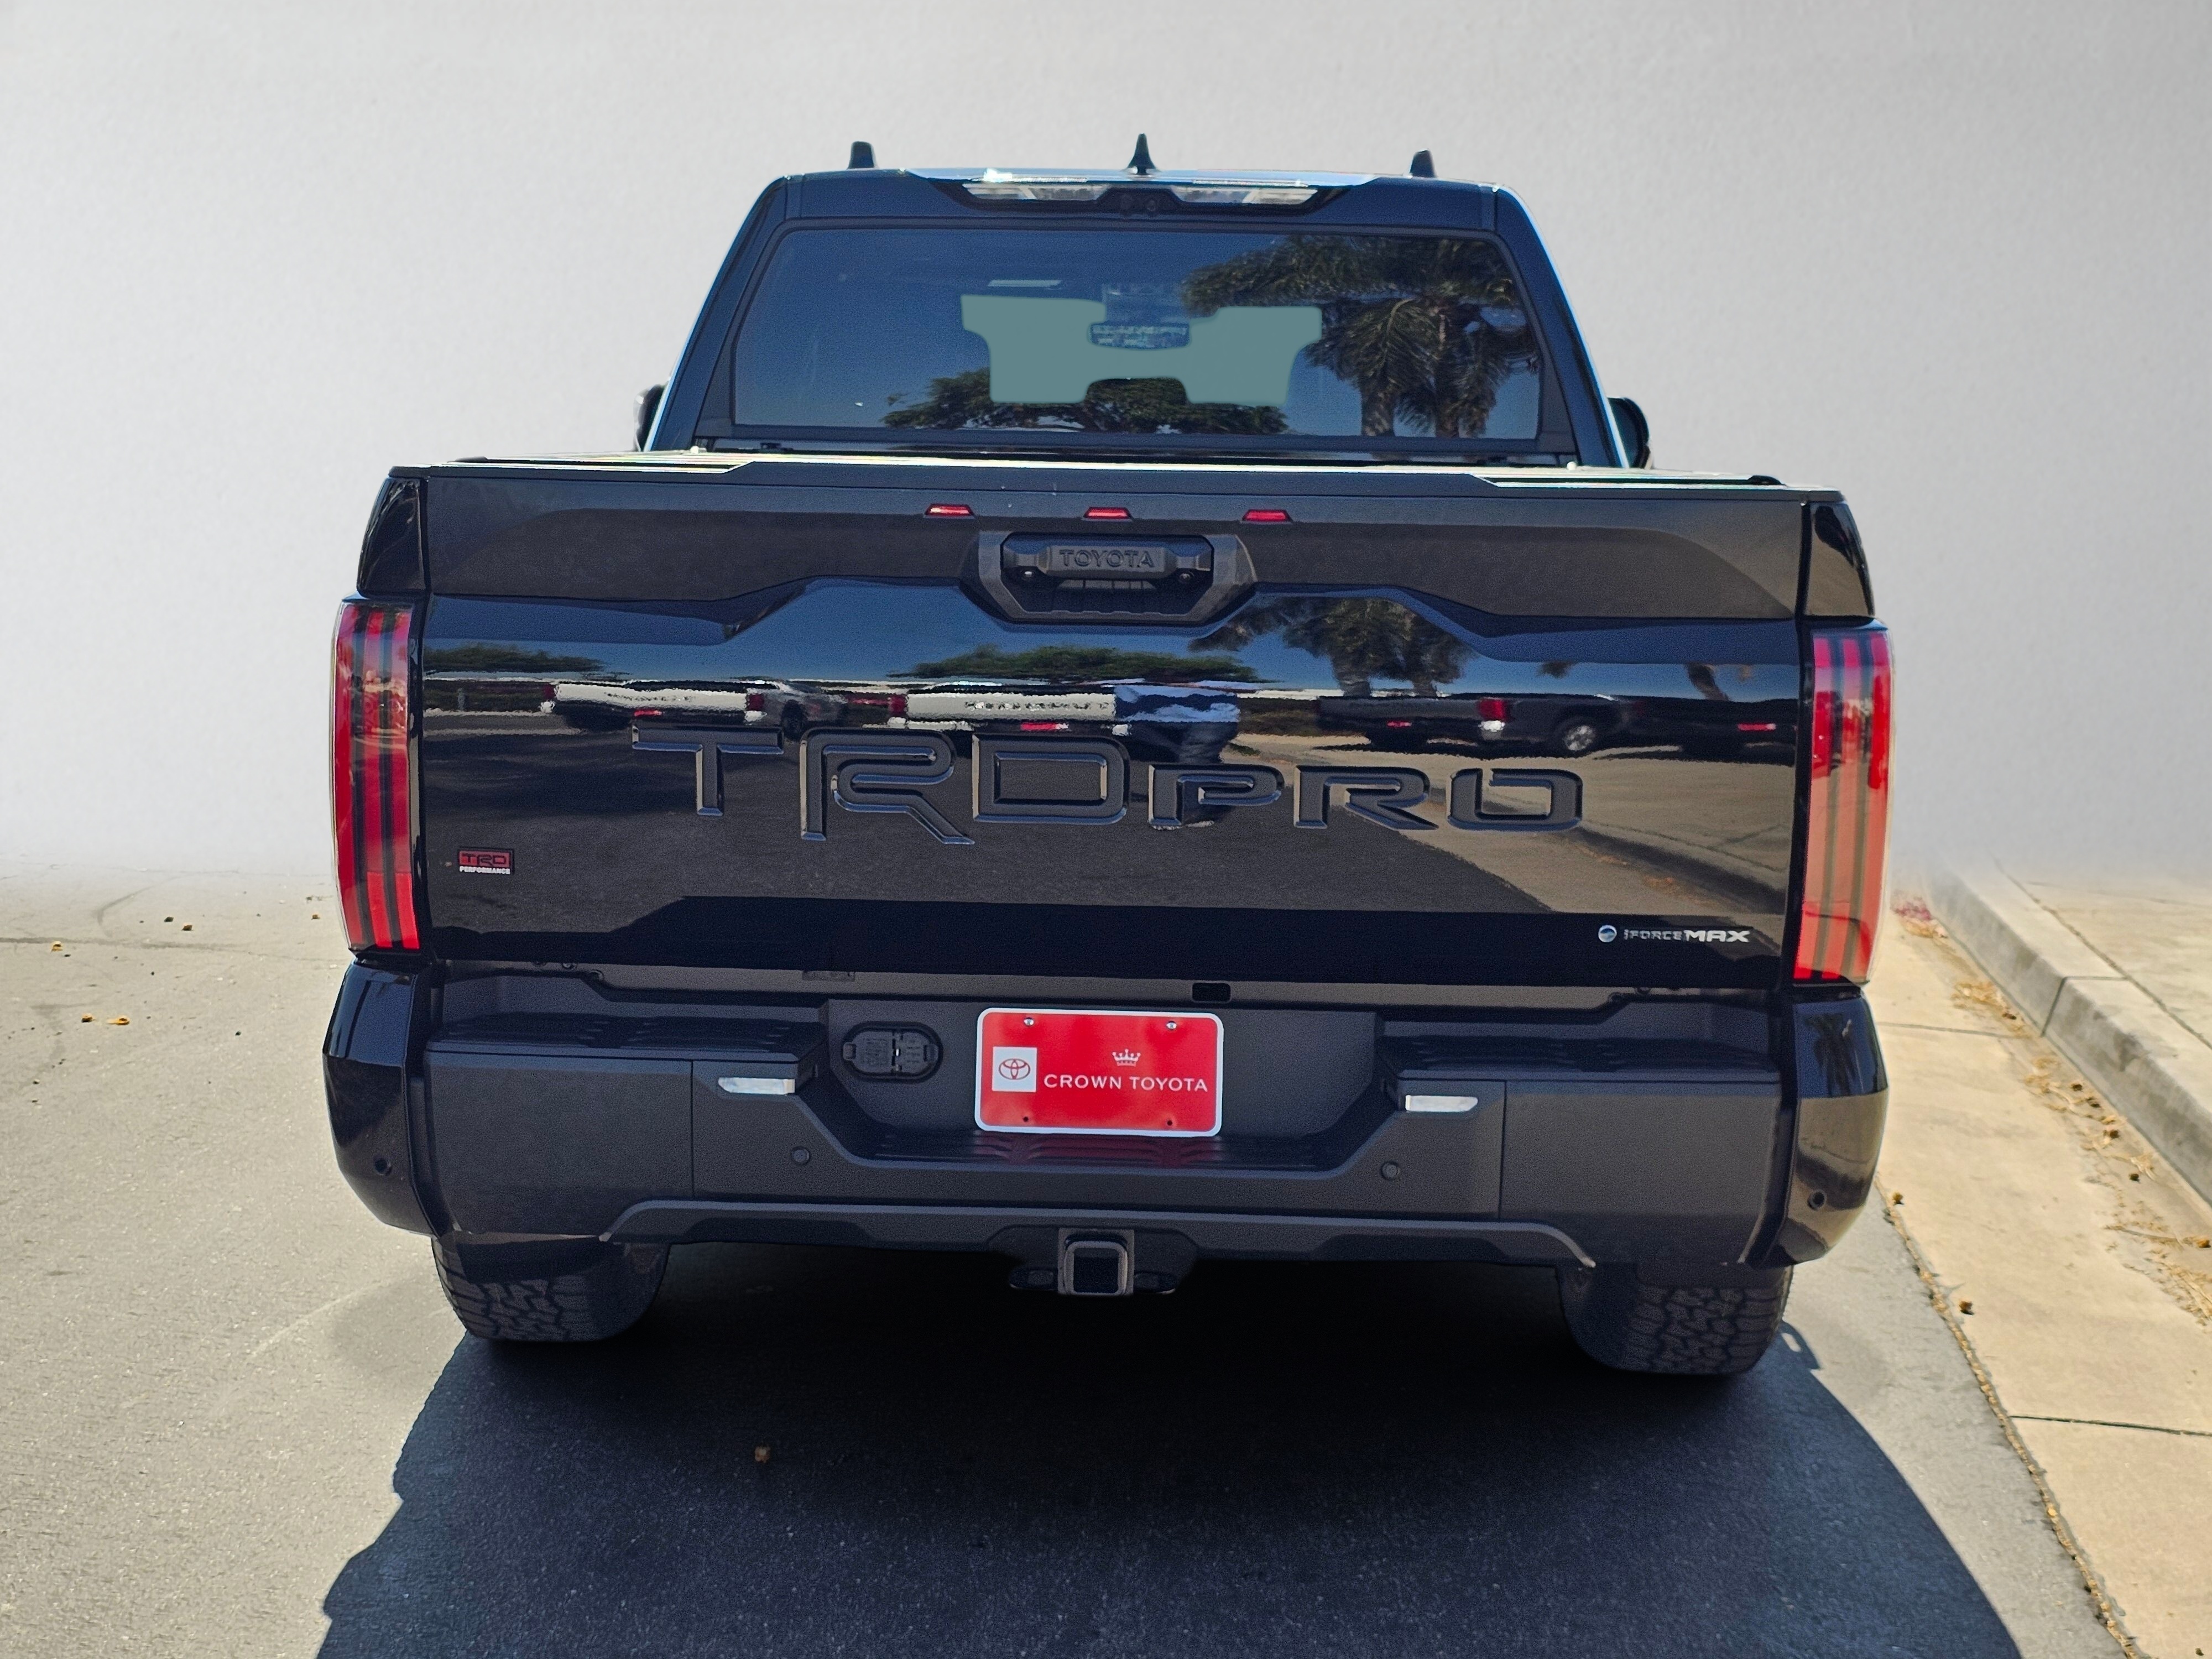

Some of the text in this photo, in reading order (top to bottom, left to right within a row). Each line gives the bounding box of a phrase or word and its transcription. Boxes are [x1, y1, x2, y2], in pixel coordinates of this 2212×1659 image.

[1059, 549, 1155, 568] TOYOTA
[461, 853, 507, 867] TRD
[459, 865, 510, 874] PERFORMANCE
[1044, 1073, 1208, 1092] CROWN TOYOTA
